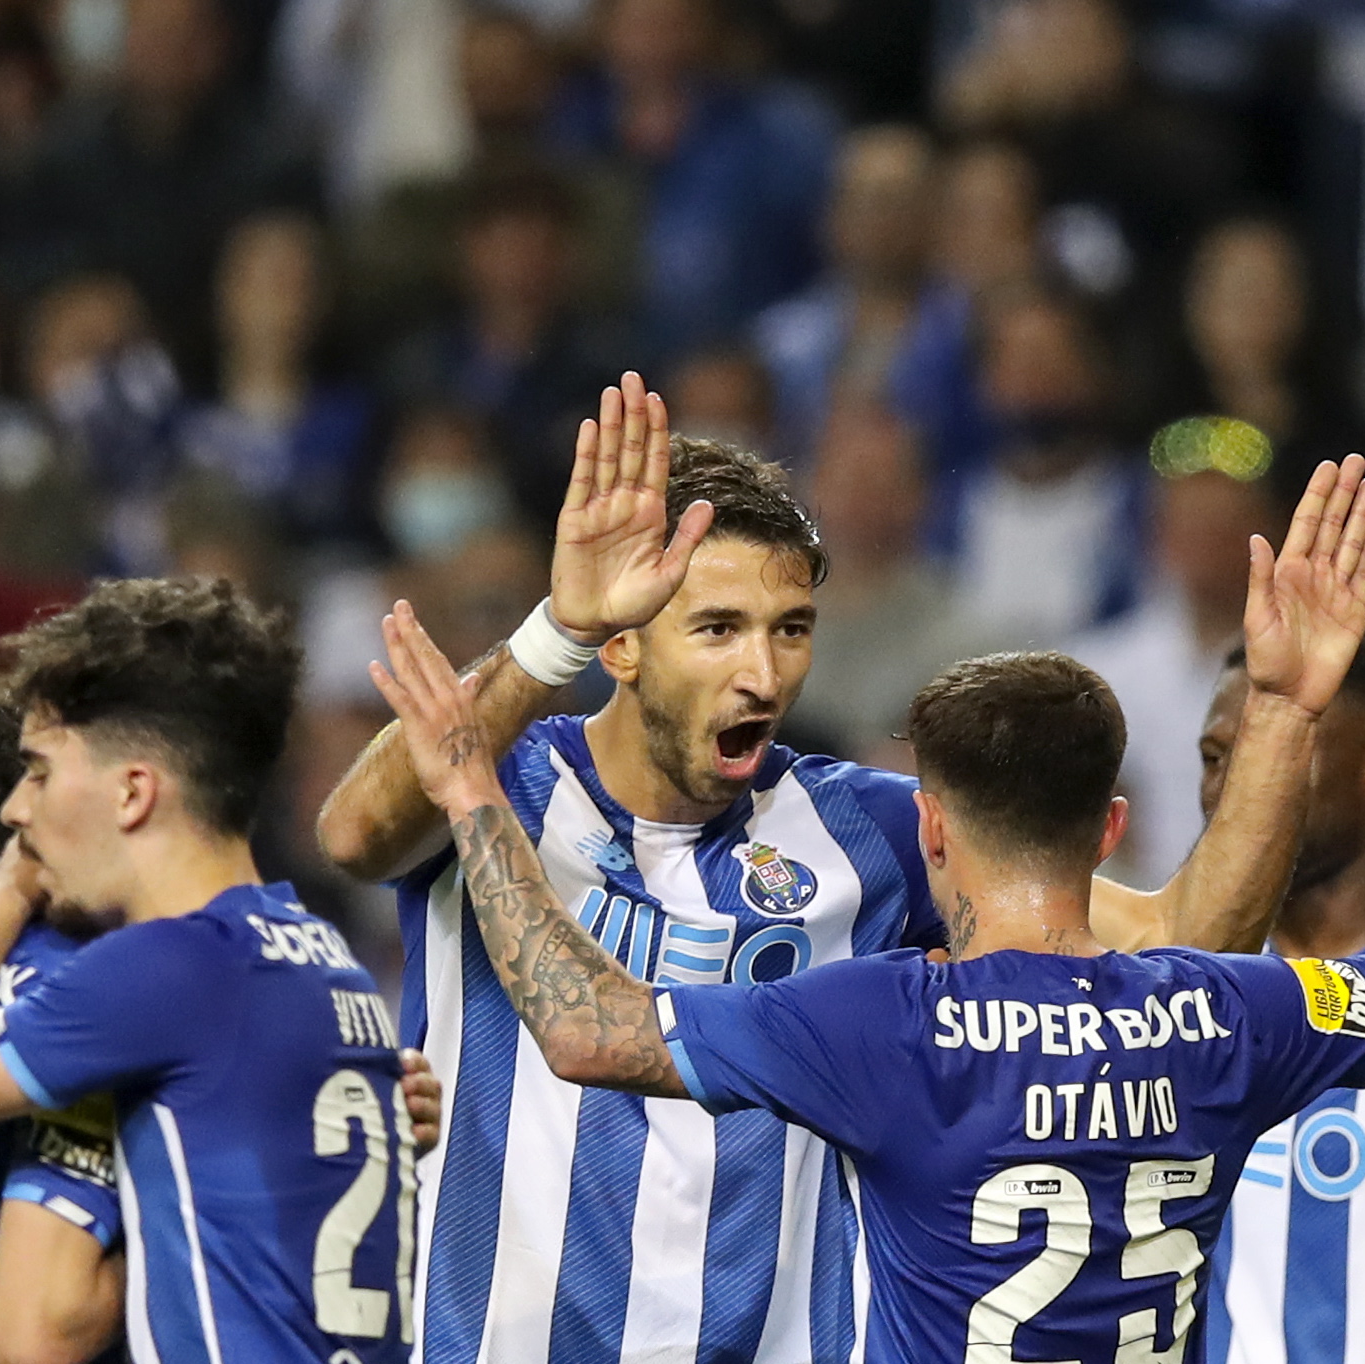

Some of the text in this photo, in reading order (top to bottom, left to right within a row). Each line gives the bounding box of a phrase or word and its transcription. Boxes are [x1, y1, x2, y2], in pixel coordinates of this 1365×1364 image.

[1314, 988, 1330, 1018] LIGA
[934, 996, 1108, 1056] SUPER
[1024, 1062, 1178, 1140] OTÁVIO
[1030, 1181, 1058, 1194] bwin
